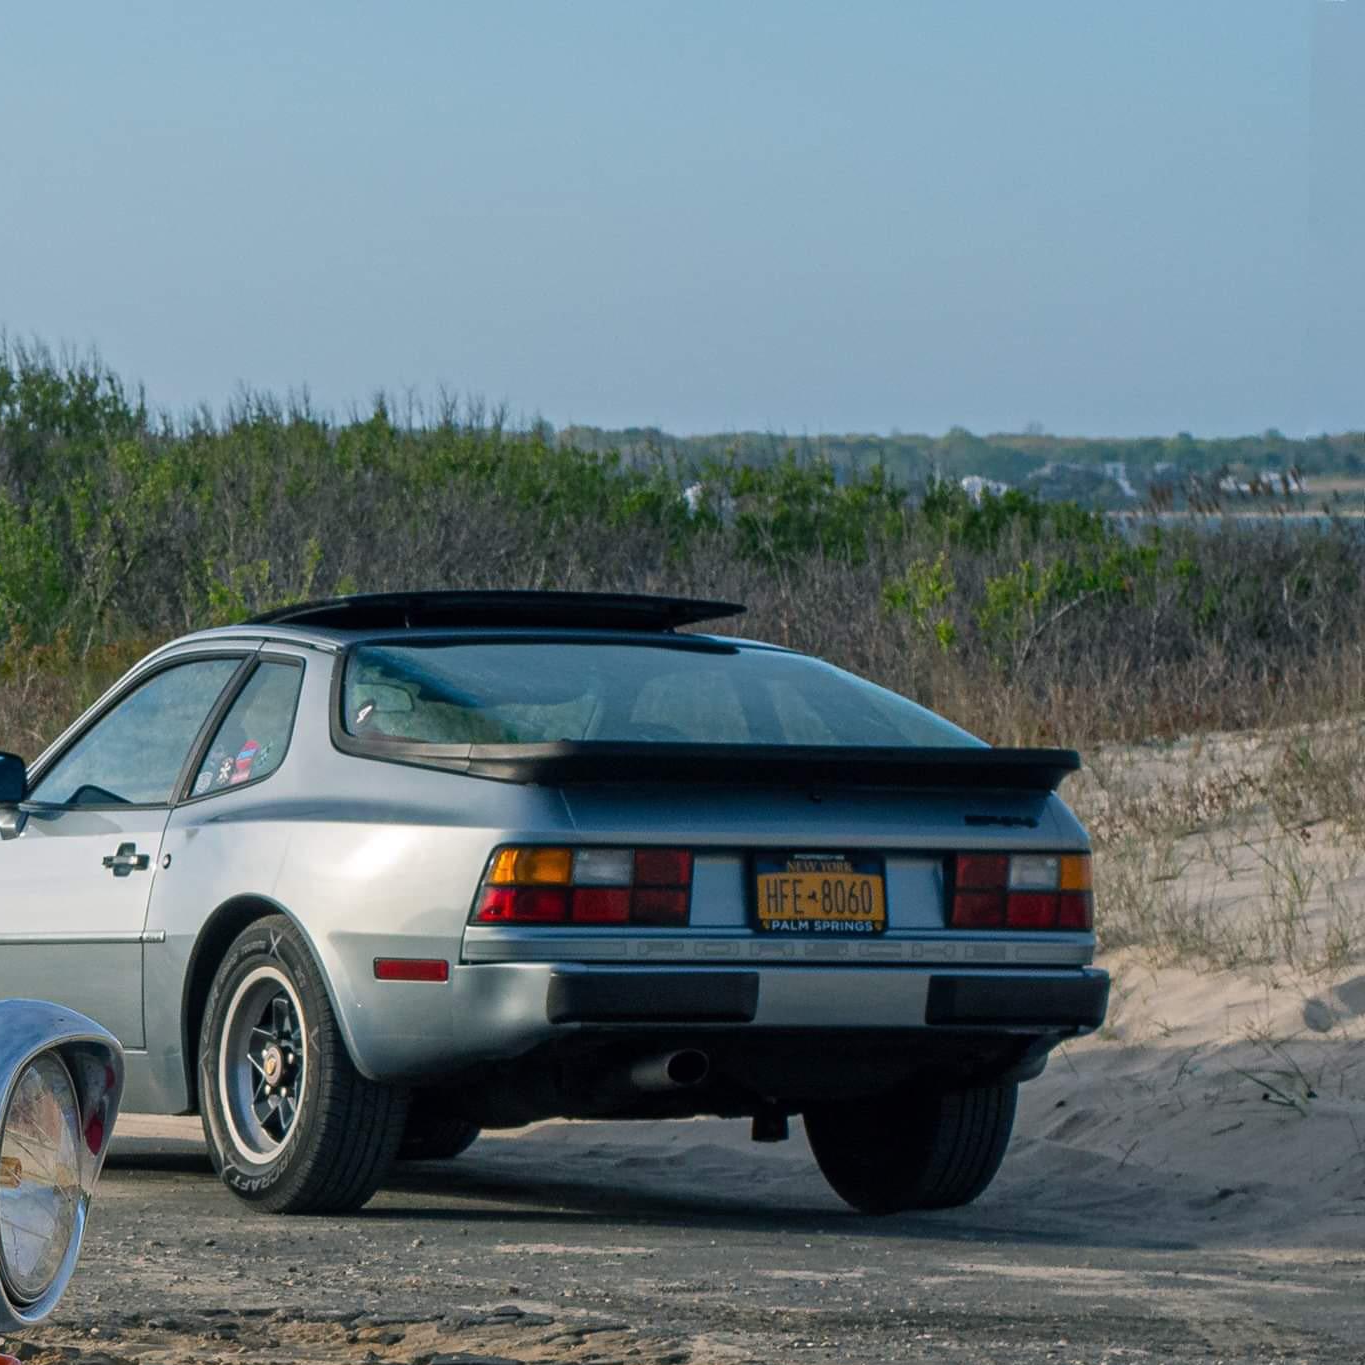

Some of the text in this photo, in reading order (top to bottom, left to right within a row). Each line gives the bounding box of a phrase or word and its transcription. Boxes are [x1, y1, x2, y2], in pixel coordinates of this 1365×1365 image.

[787, 861, 854, 872] NEW YORK
[765, 878, 873, 914] HFE 8060
[771, 920, 874, 932] PALM SPRINGS
[638, 941, 1007, 961] PORSCHE
